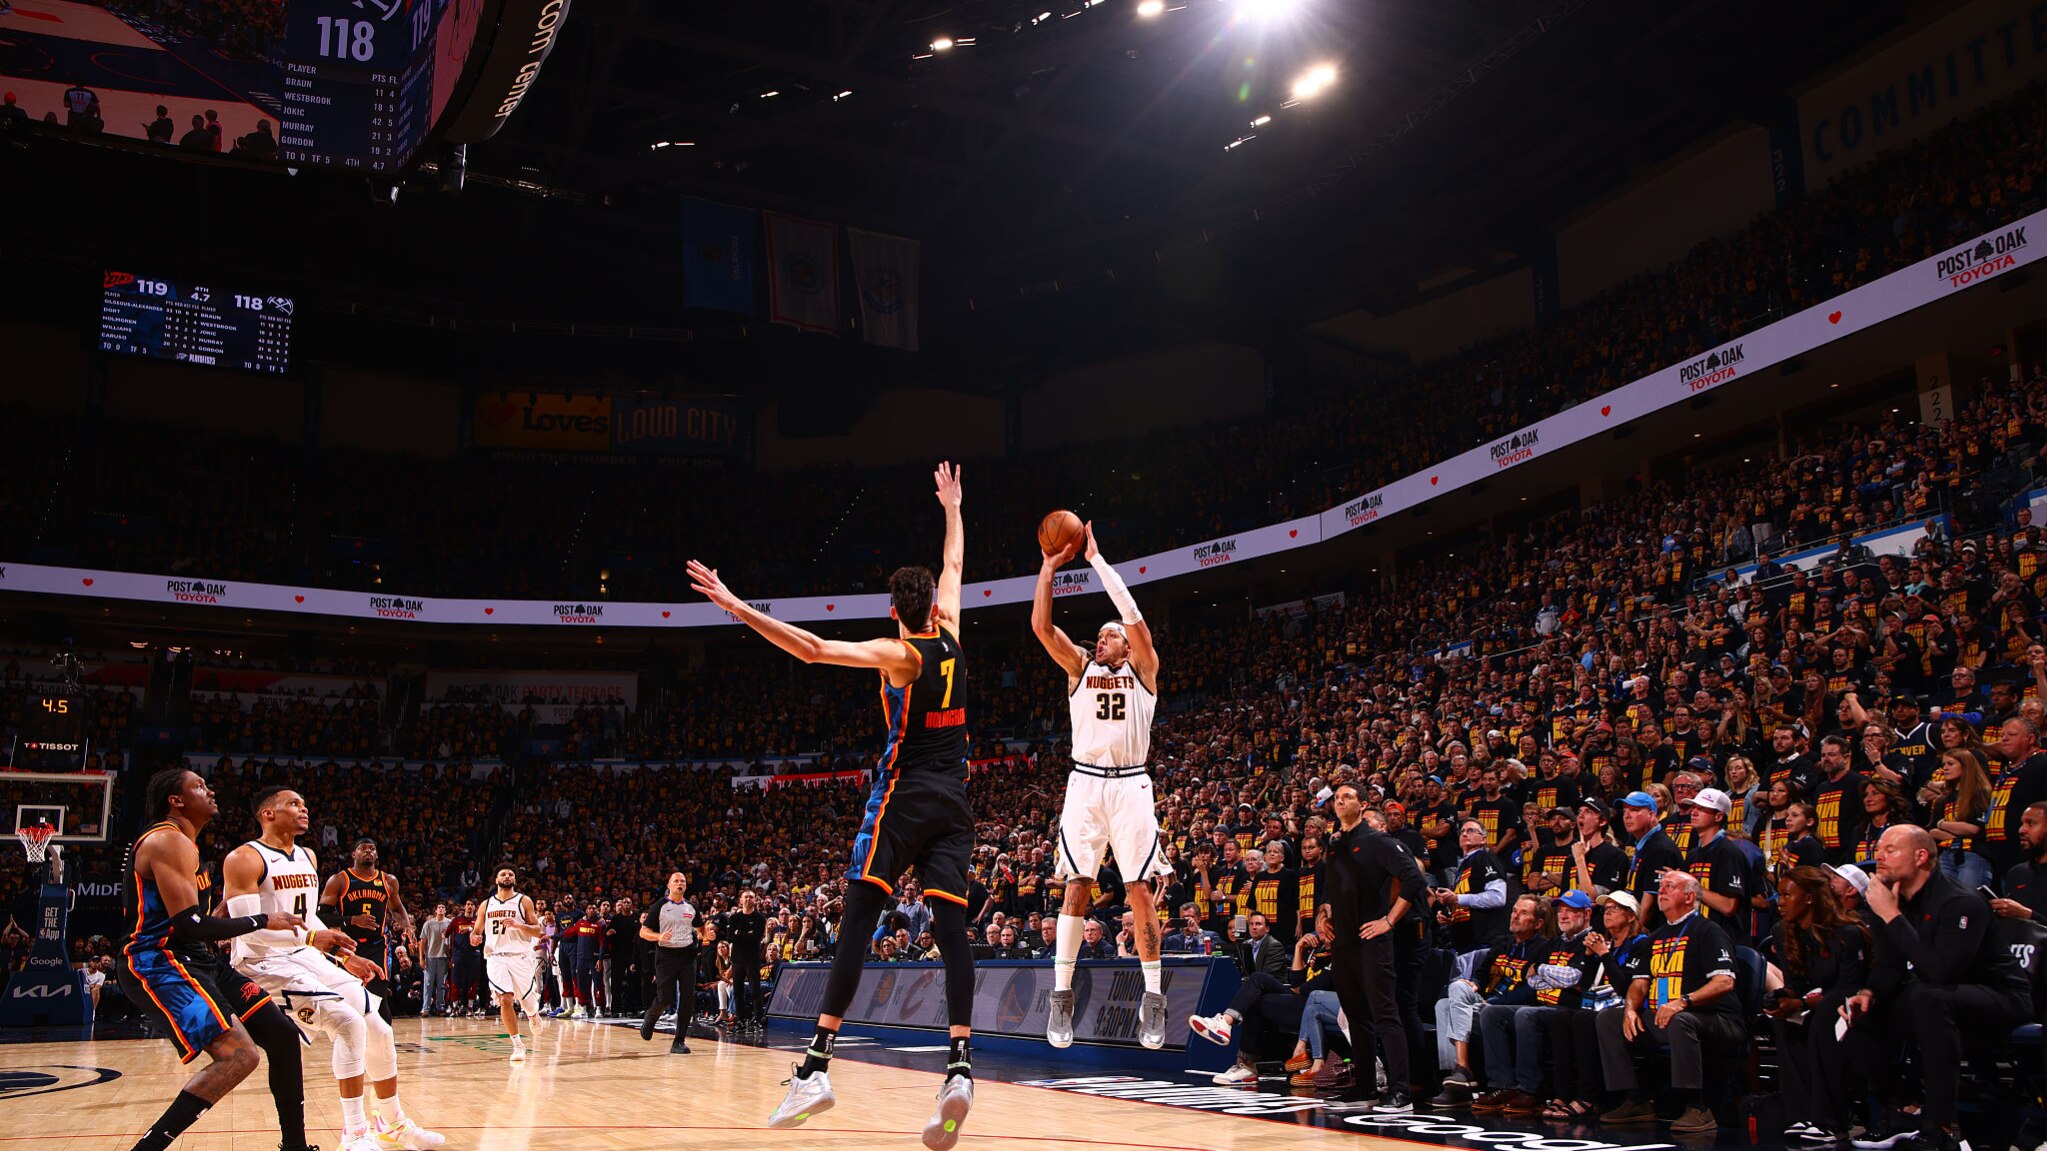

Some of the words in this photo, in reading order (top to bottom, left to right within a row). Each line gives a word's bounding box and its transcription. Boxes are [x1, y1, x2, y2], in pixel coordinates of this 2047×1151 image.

[317, 16, 375, 62] 118
[288, 63, 317, 75] PLAYER
[372, 74, 386, 83] PTS
[389, 75, 399, 84] FL
[285, 78, 313, 89] BRAUN
[375, 89, 384, 97] 11
[495, 61, 540, 118] center
[284, 91, 332, 106] WESTBROOK
[388, 104, 394, 113] 5
[283, 106, 305, 116] JOKIC
[372, 118, 382, 126] 42
[388, 119, 393, 127] 5
[282, 121, 314, 133] MURRAY
[372, 132, 381, 140] 21
[387, 133, 392, 142] 3
[281, 135, 314, 147] GORDON
[386, 147, 391, 156] 2
[286, 151, 296, 160] TO
[311, 154, 321, 163] TF
[325, 155, 331, 164] 5
[345, 158, 360, 167] 4TH
[372, 162, 385, 171] 4.7
[1937, 248, 1973, 278] POST
[1995, 226, 2027, 255] OAK
[1950, 254, 2015, 288] TOYOTA
[137, 279, 168, 296] 119
[234, 294, 263, 311] 118
[191, 292, 211, 302] 4.7
[200, 312, 222, 320] BRAUN
[102, 324, 132, 333] WILLIAMS
[200, 321, 237, 331] WESTBROOK
[101, 332, 127, 341] CARUSO
[198, 346, 224, 355] GORDON
[1680, 363, 1706, 383] POST
[1721, 344, 1744, 367] OAK
[1689, 367, 1736, 392] TOYOTA
[617, 406, 678, 444] LOUD
[687, 407, 737, 447] CITY
[1490, 441, 1510, 460] POST
[1522, 429, 1539, 448] OAK
[1497, 448, 1533, 468] TOYOTA
[1345, 502, 1361, 519] POST
[1369, 493, 1383, 509] OAK
[1350, 510, 1378, 527] TOYOTA
[1194, 545, 1212, 560] POST
[1221, 539, 1236, 554] OAK
[1200, 554, 1231, 567] TOYOTA
[1074, 572, 1089, 584] OAK
[167, 580, 192, 592] POST
[206, 584, 226, 596] OAK
[1052, 585, 1083, 595] TOYOTA
[175, 593, 217, 603] TOYOTA
[370, 597, 392, 608] POST
[405, 600, 423, 611] OAK
[377, 609, 415, 618] TOYOTA
[554, 604, 575, 615] POST
[586, 605, 603, 616] OAK
[755, 602, 771, 614] OAK
[560, 615, 596, 624] TOYOTA
[940, 657, 956, 709] 7
[1086, 676, 1135, 690] NUGGETS
[495, 686, 518, 698] OAK
[567, 686, 623, 699] TERRACE
[42, 698, 68, 713] 4.5
[1096, 692, 1126, 720] 32
[39, 743, 79, 751] TISSOT
[272, 874, 318, 890] NUGGETS
[347, 889, 387, 903] OKLAHOMA
[45, 907, 59, 917] GET
[294, 893, 308, 923] 4
[362, 903, 371, 916] 5
[487, 909, 516, 919] NUGGETS
[44, 917, 58, 928] THE
[46, 928, 60, 941] App
[30, 957, 63, 967] Google
[1107, 971, 1174, 1002] TOMOW
[1093, 1005, 1136, 1038] 9:30PM
